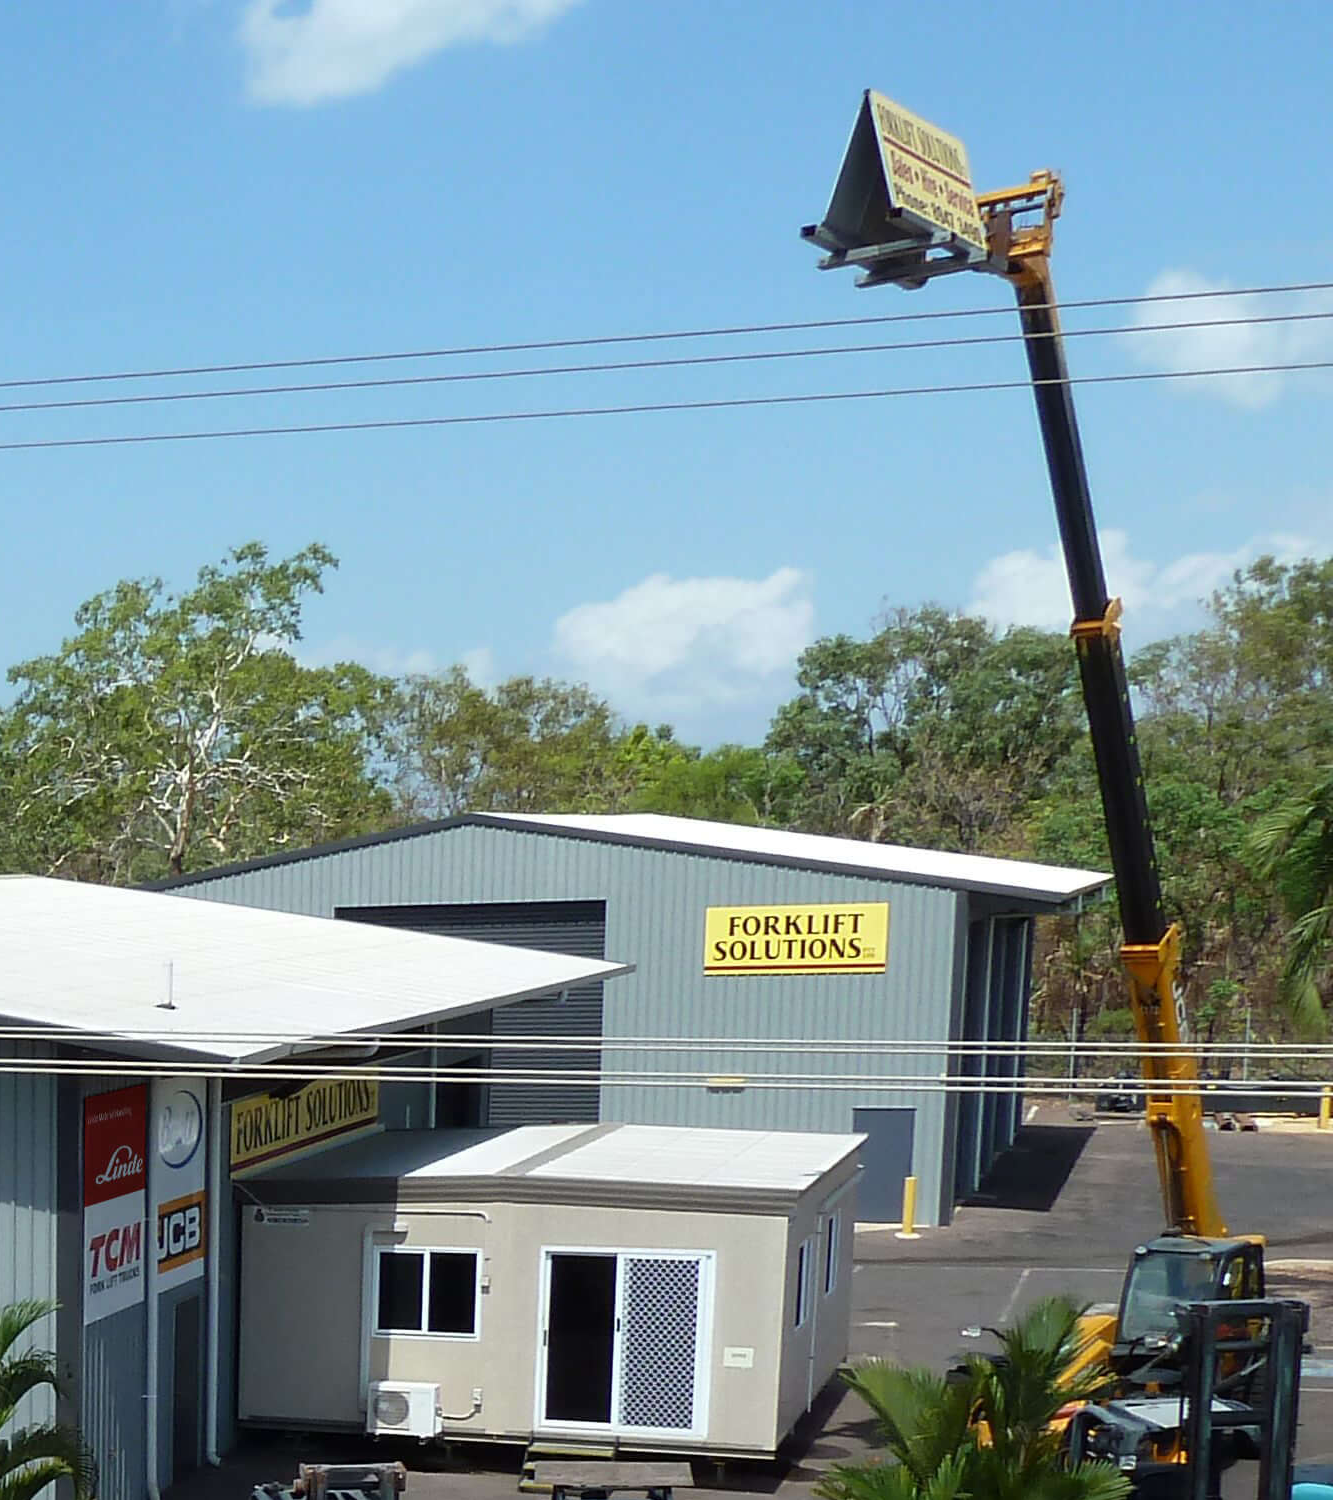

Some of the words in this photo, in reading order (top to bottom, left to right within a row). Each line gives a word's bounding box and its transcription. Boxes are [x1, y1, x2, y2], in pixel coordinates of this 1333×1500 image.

[729, 913, 865, 936] FORKLIFT
[713, 938, 862, 961] SOLUTIONS
[236, 1095, 301, 1155] FORKLIFT
[305, 1080, 371, 1131] SOLUTIONS
[95, 1145, 143, 1184] Linde
[89, 1221, 141, 1279] TCM
[157, 1206, 200, 1260] JCB
